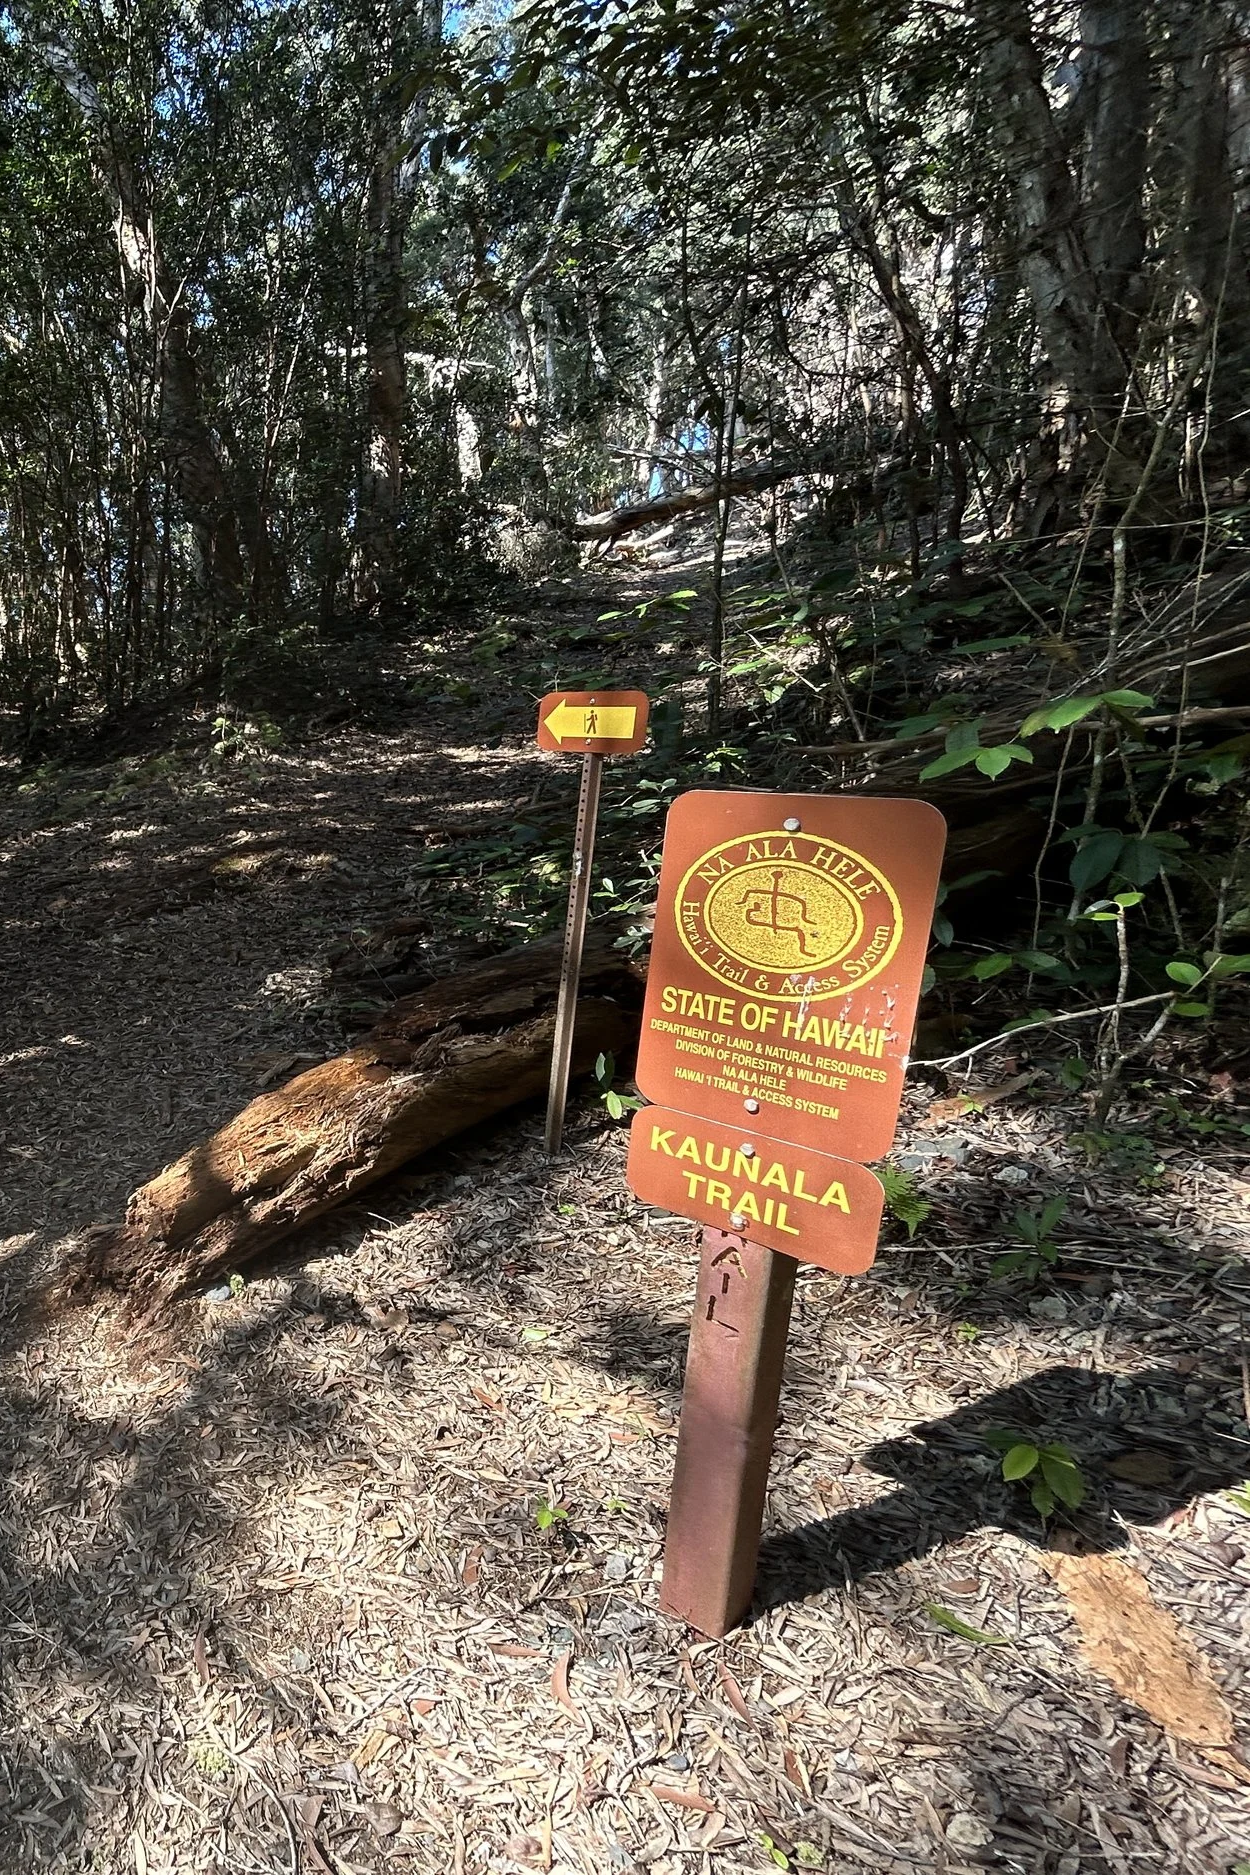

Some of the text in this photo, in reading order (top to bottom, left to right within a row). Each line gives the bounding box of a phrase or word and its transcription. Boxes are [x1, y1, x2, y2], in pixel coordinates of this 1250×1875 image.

[746, 839, 798, 862] ALA
[810, 847, 881, 900] HELE
[713, 952, 750, 984] Trail
[754, 974, 770, 991] &
[778, 975, 840, 995] Access
[842, 925, 890, 979] System
[650, 1018, 887, 1084] DEPARTMENT OF LAND & NATURAL RESOURCES
[661, 986, 886, 1059] STATE OF HAWAII
[675, 1039, 848, 1091] DIVISION OF FORESTRY & WILDLIFE
[713, 1076, 740, 1094] TRAIL
[742, 1084, 750, 1096] &
[751, 1087, 793, 1108] ACCESS
[794, 1098, 839, 1120] SYSTEM
[722, 1065, 787, 1091] NA ALA HELE
[650, 1126, 851, 1214] KAUNALA
[682, 1170, 800, 1236] TRAIL
